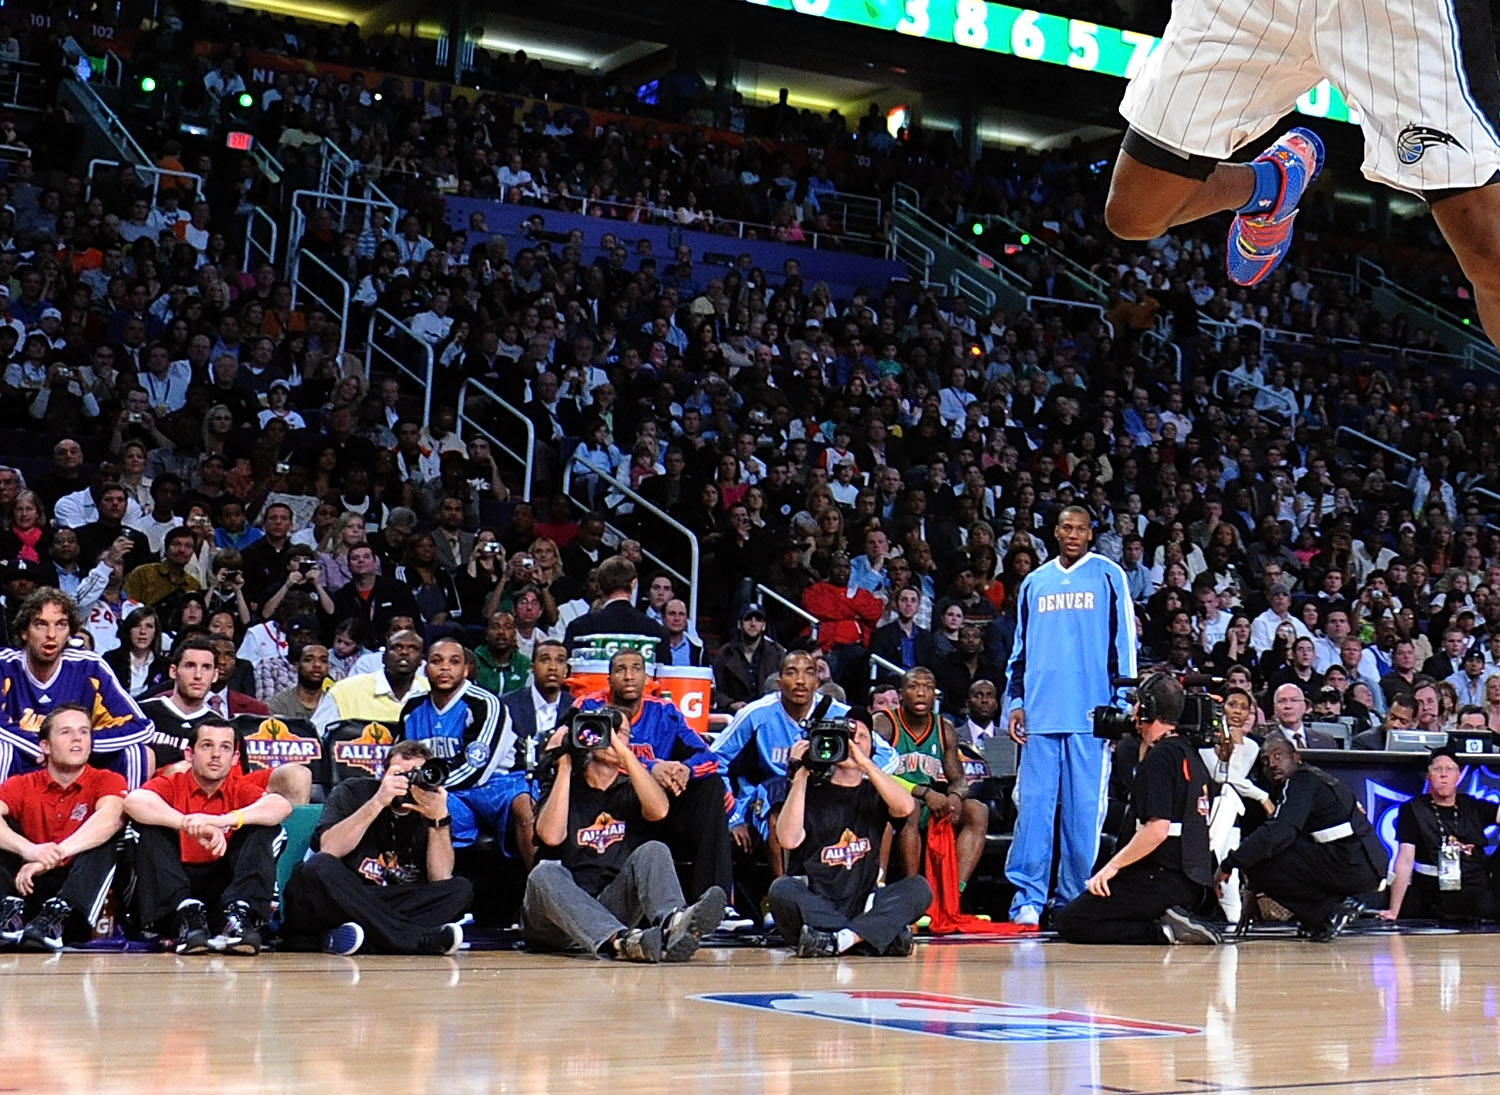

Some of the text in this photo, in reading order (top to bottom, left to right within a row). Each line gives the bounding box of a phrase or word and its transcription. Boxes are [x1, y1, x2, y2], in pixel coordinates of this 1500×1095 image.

[92, 23, 115, 39] 102
[1037, 591, 1096, 614] DENVER
[90, 608, 114, 624] 24
[680, 692, 704, 719] G
[96, 918, 110, 934] G
